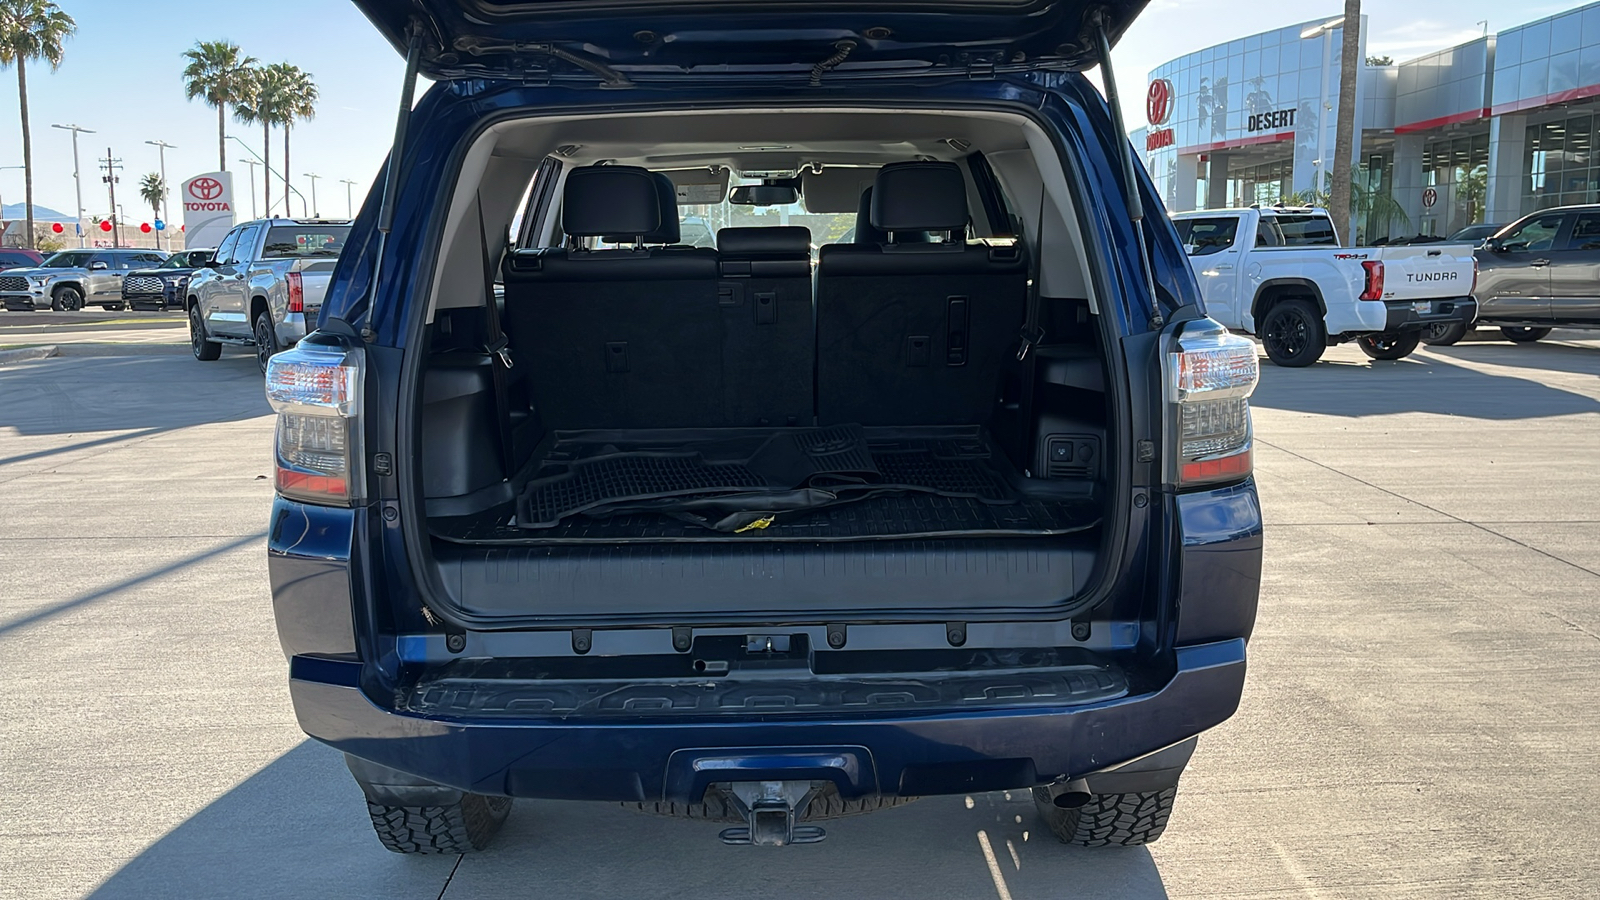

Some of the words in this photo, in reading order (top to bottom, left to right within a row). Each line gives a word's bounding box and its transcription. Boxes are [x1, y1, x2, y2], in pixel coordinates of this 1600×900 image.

[1248, 108, 1297, 132] DESERT
[184, 202, 231, 212] TOYOTA
[1406, 272, 1458, 282] TUNDRA
